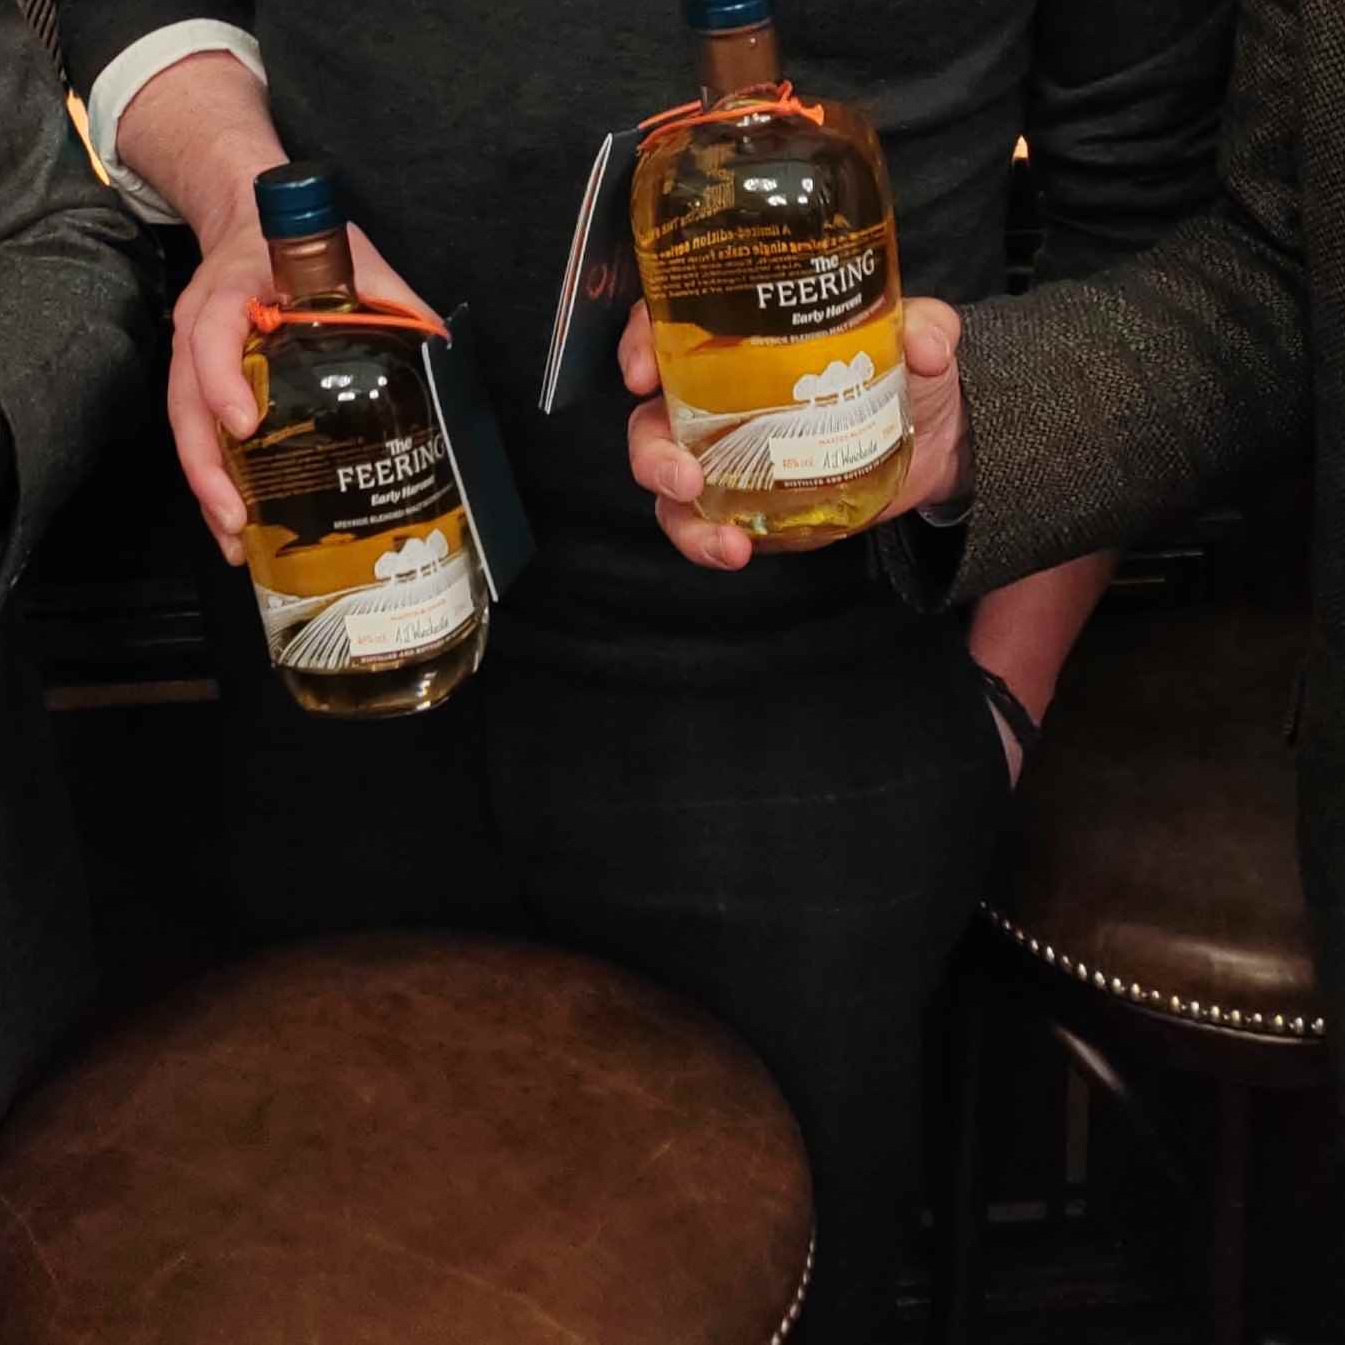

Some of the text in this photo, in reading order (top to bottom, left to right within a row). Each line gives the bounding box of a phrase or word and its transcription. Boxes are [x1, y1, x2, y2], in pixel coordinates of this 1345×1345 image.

[810, 255, 839, 273] The
[756, 249, 875, 309] FEERING
[792, 310, 824, 325] Early
[385, 437, 413, 455] The
[371, 490, 401, 507] Early
